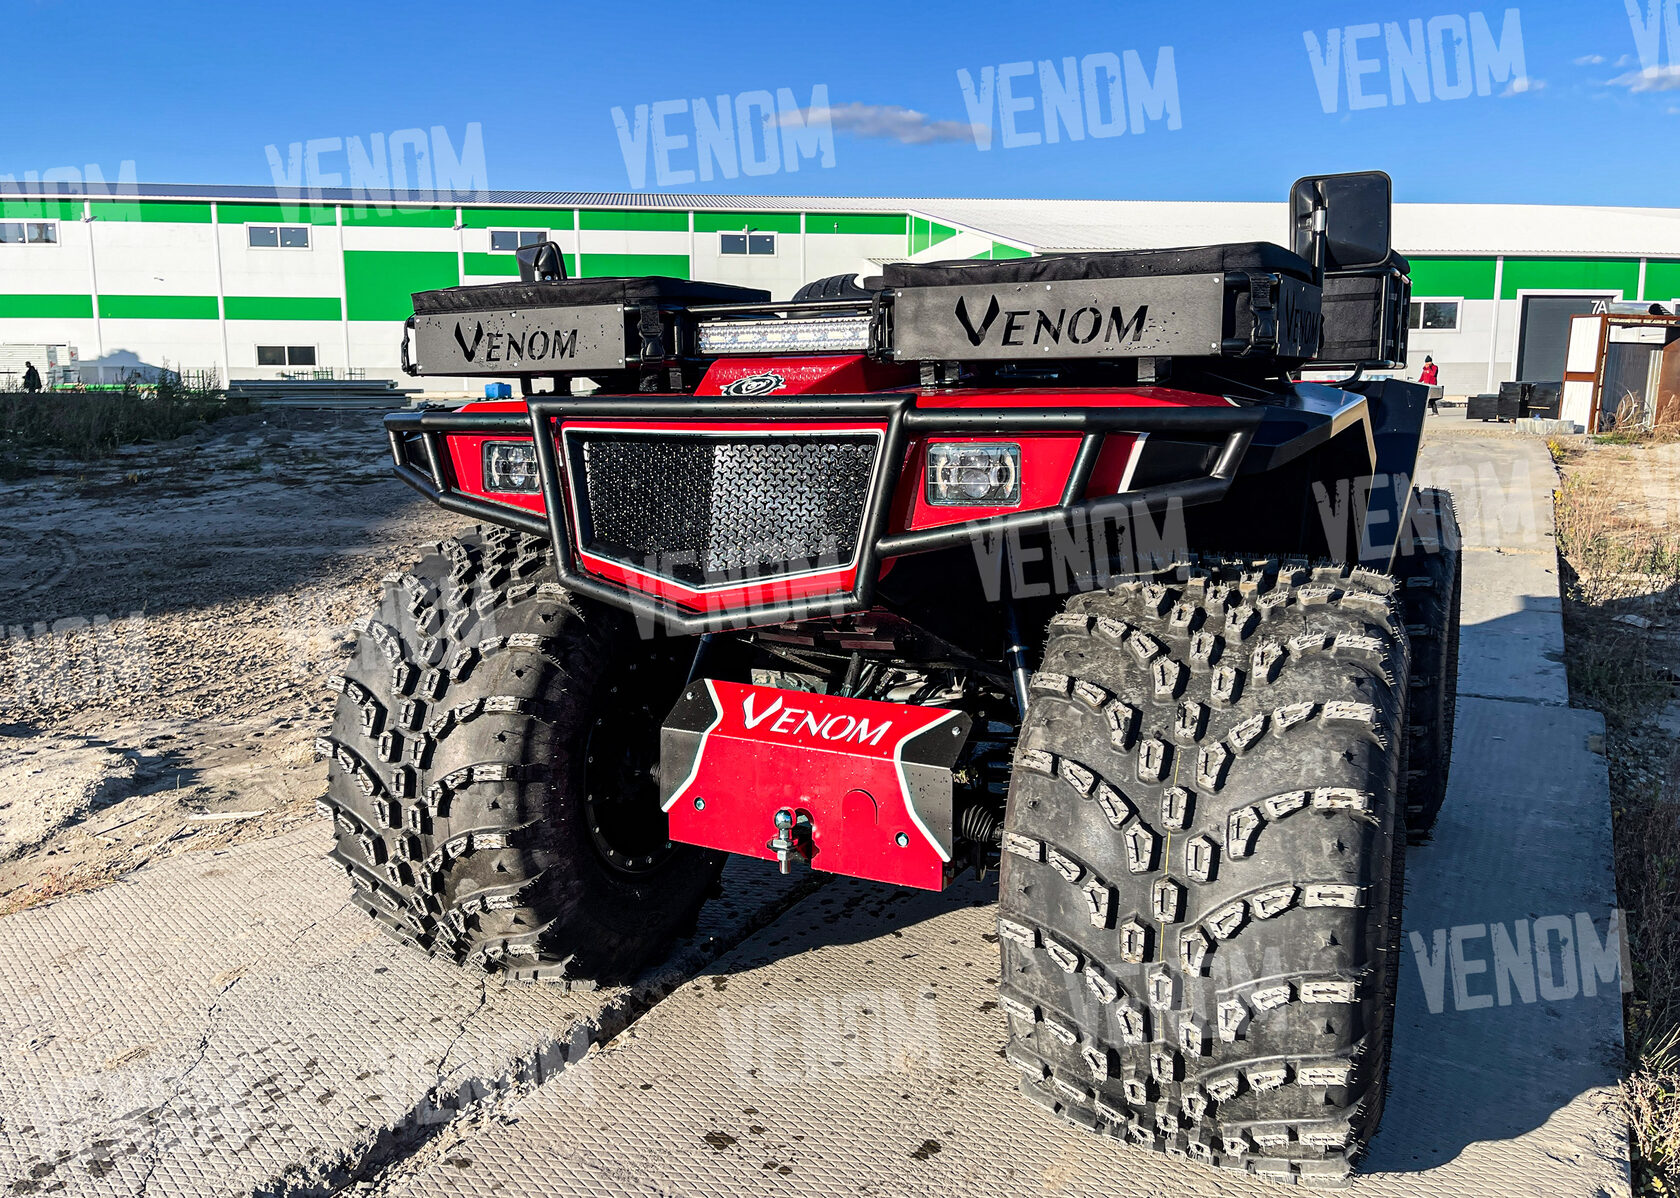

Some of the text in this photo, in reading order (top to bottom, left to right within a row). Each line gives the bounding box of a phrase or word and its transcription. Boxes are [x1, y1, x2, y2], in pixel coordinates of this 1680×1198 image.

[454, 321, 578, 362] VENOM
[955, 294, 1149, 346] VENOM
[742, 692, 893, 746] VENOM
